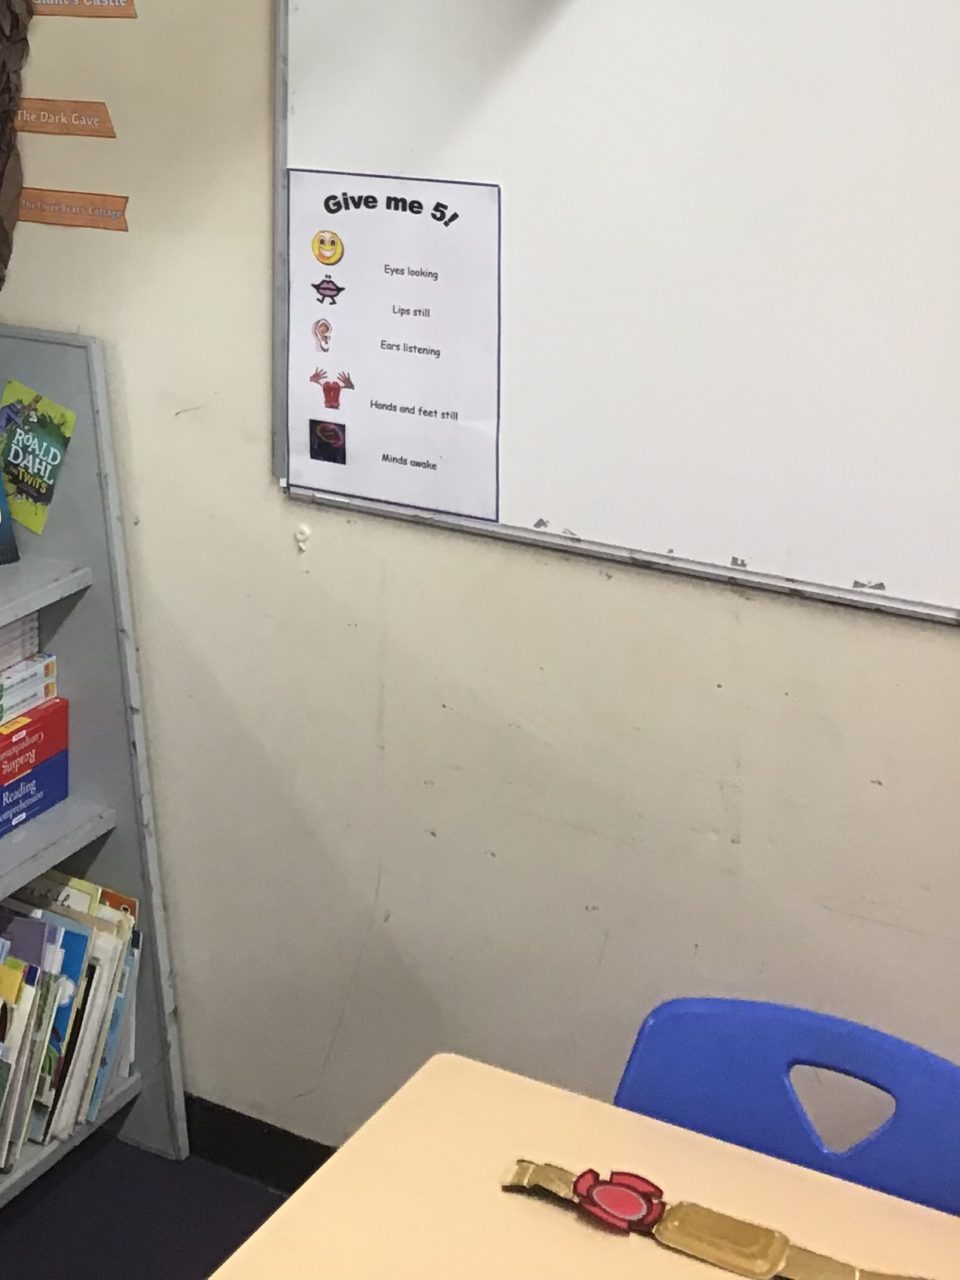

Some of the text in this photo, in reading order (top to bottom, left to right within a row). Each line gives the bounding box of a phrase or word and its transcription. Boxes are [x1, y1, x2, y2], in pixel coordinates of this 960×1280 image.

[17, 109, 101, 126] The Dark Cave
[324, 192, 460, 228] Give me 5!
[383, 264, 439, 281] Eyes looking
[392, 305, 431, 318] Lips still
[380, 340, 442, 359] Ears listening
[369, 399, 459, 421] Hands and feet still
[11, 427, 61, 466] ROALD
[7, 443, 54, 486] DAHL
[381, 453, 438, 471] Minds awake
[17, 467, 48, 494] TWITS
[1, 748, 36, 775] Reading
[2, 779, 37, 807] Reading
